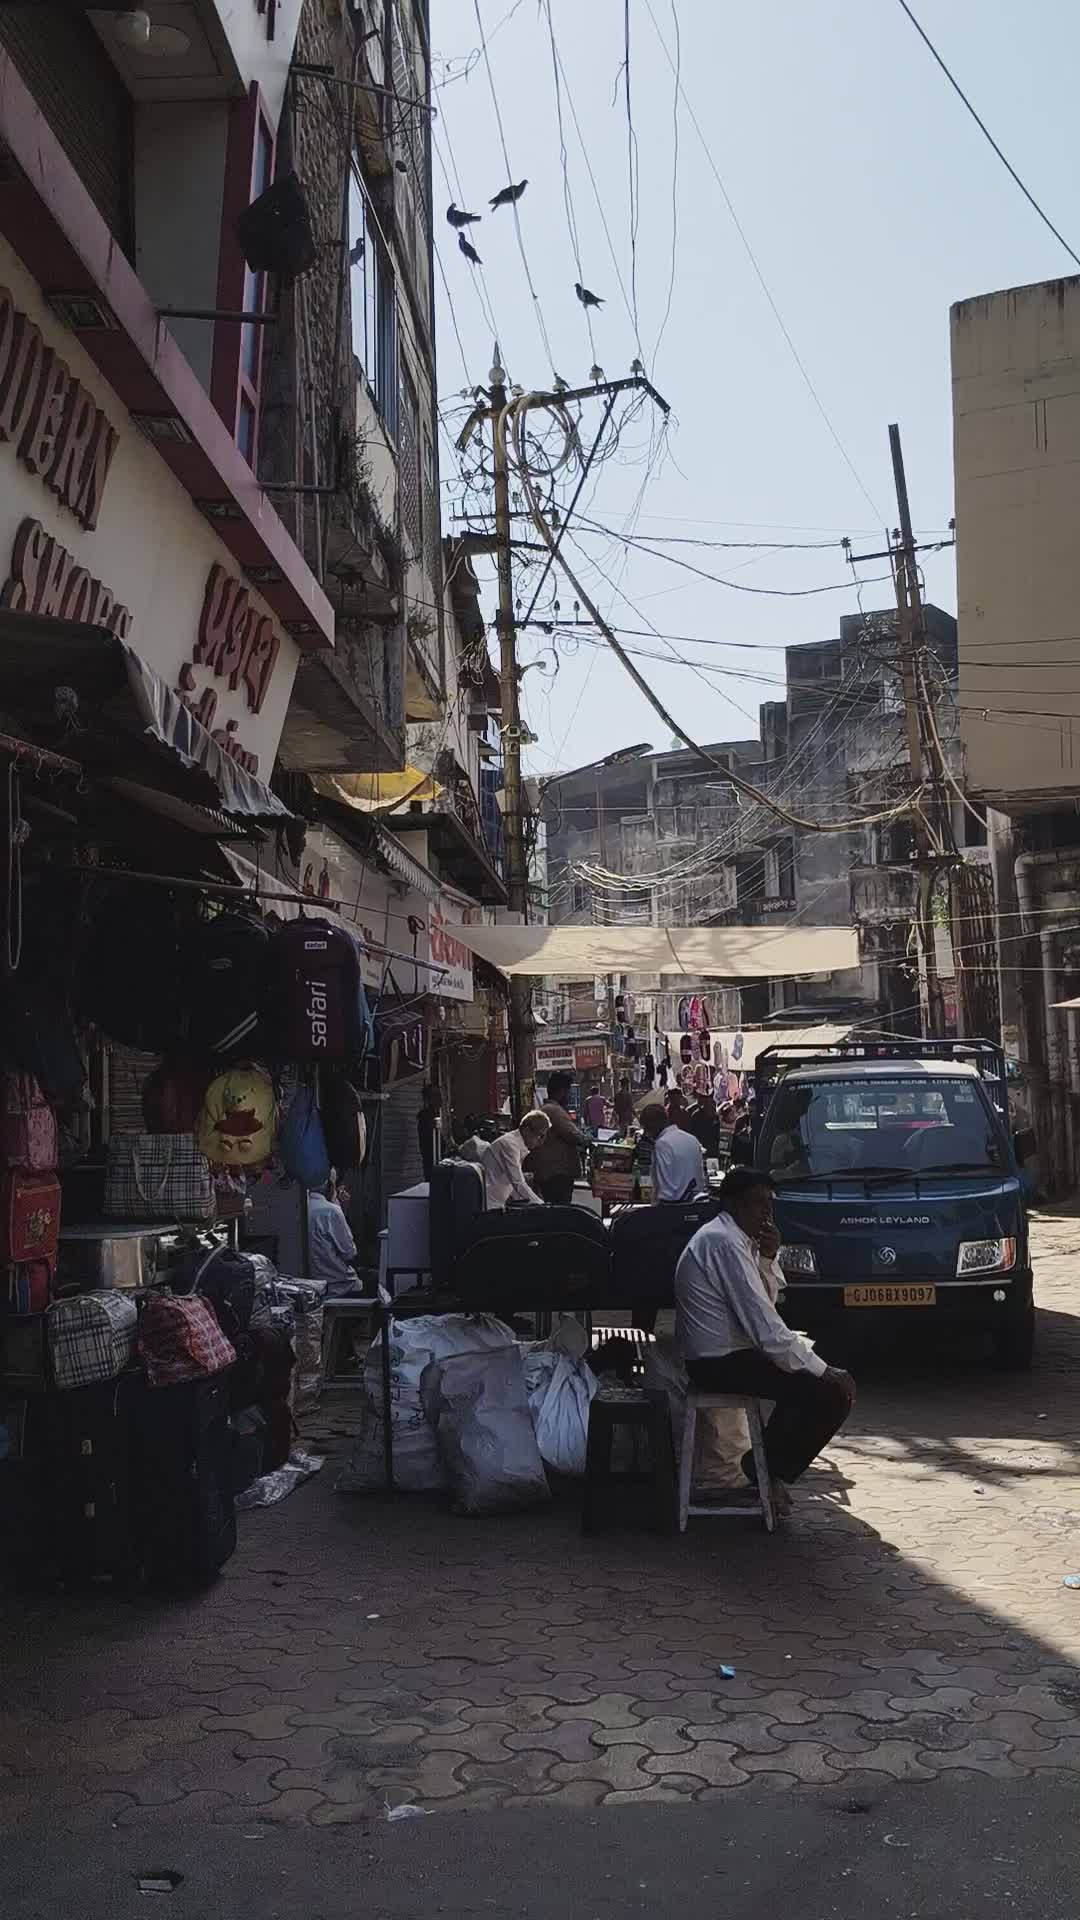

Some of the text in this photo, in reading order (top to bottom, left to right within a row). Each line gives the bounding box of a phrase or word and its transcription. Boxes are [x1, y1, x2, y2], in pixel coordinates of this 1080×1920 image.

[305, 980, 327, 1048] safari
[839, 1216, 931, 1225] ASHOK LEYLAND
[853, 1287, 933, 1302] GJ06BX9097
